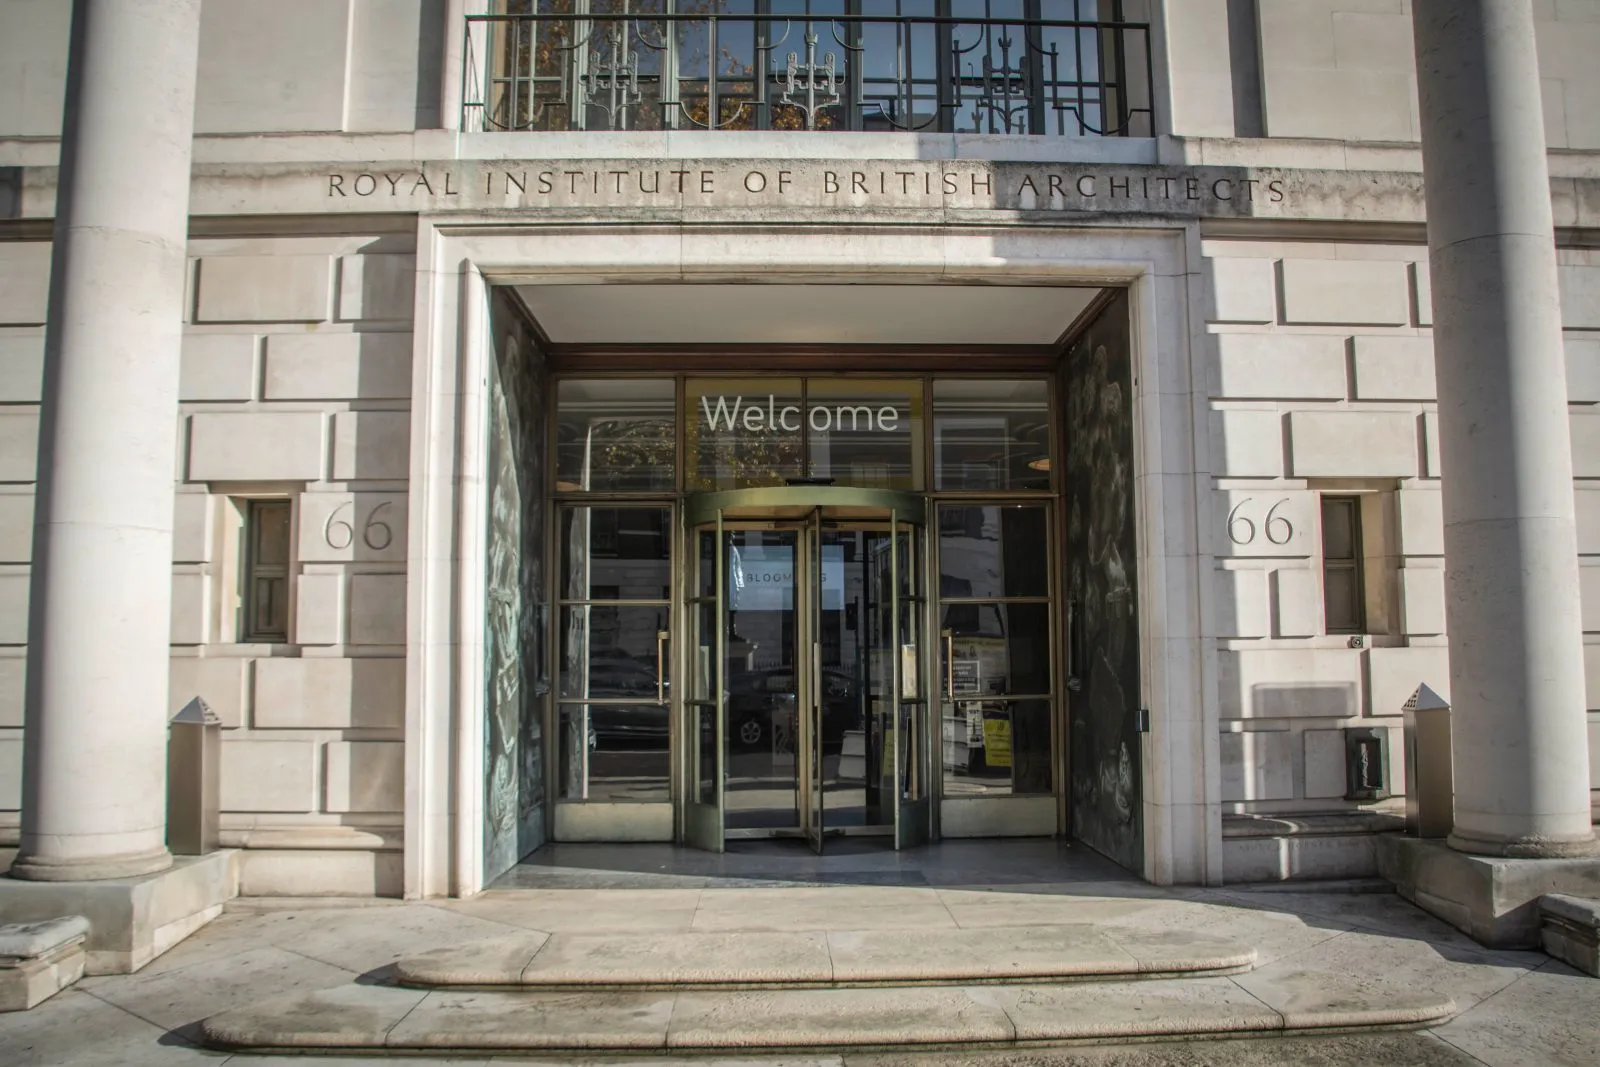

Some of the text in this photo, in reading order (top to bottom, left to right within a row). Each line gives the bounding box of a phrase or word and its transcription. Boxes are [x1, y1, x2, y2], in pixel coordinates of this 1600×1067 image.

[327, 170, 1284, 203] ROYAL INSTITUTE OF BRITISH ARCHITECTS
[701, 394, 899, 432] Welcome
[326, 500, 393, 551] 66
[1227, 497, 1293, 545] 66
